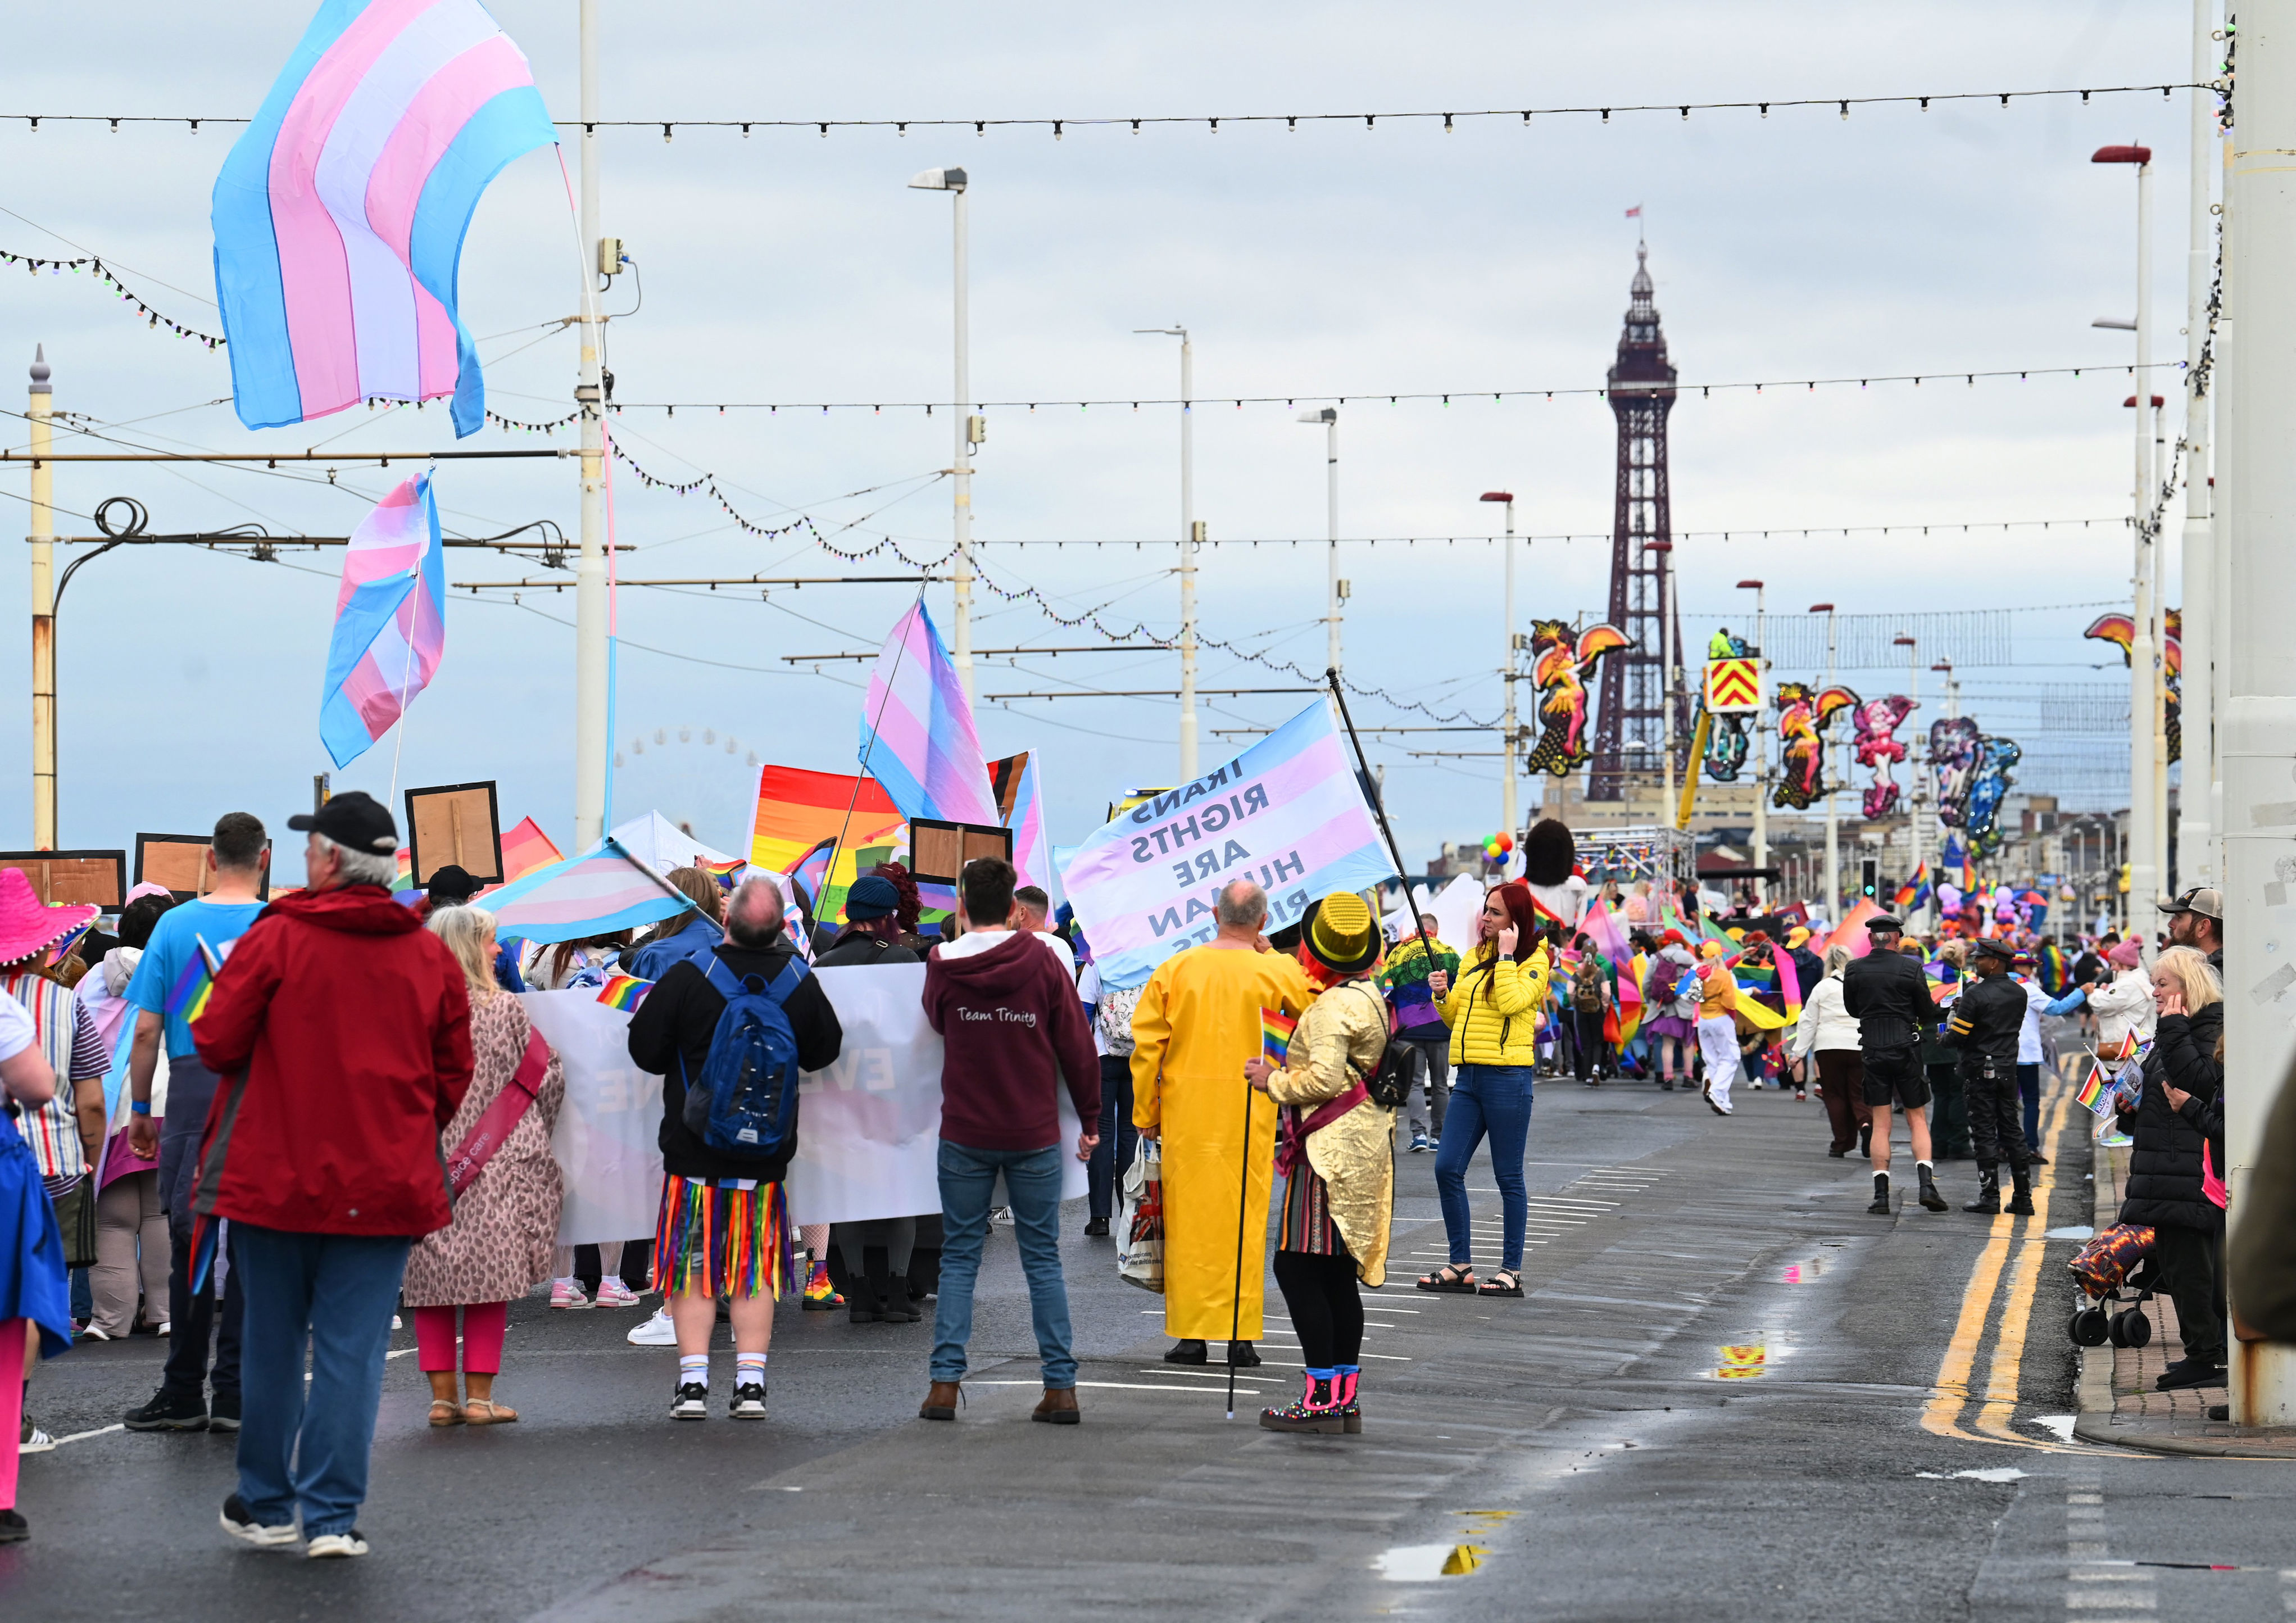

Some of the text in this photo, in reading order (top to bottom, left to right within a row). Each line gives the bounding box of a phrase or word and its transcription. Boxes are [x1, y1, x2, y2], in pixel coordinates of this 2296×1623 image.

[957, 1007, 1036, 1028] Team Trinity
[450, 1132, 489, 1185] spice care
